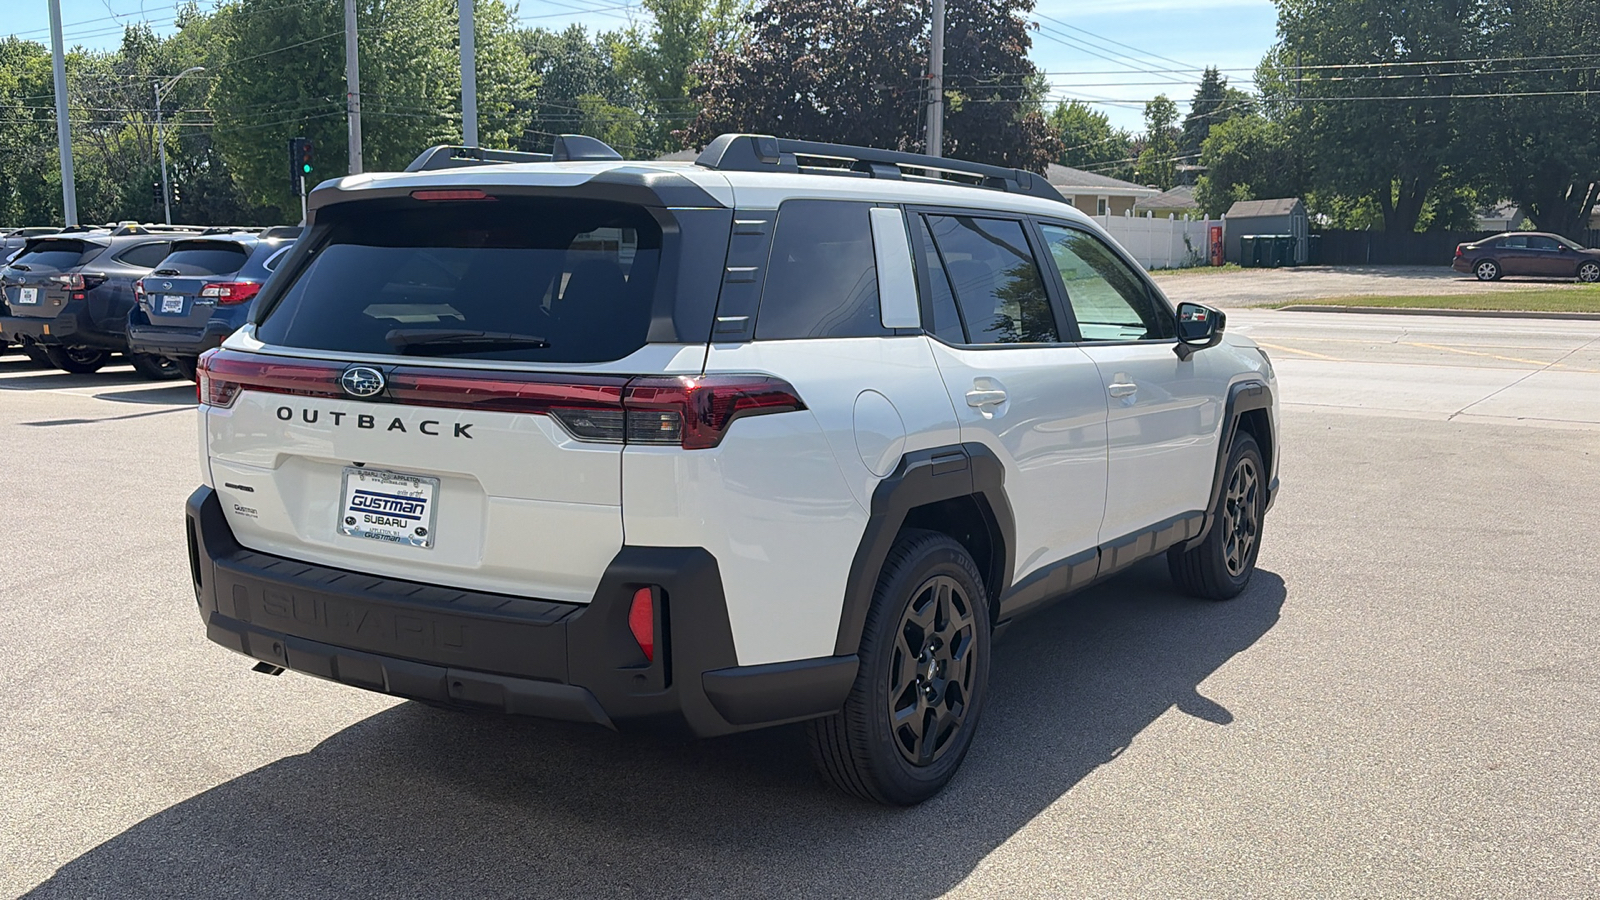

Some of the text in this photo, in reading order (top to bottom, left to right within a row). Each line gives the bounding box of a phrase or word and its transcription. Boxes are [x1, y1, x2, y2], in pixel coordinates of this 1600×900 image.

[276, 406, 473, 439] OUTBACK
[363, 514, 408, 528] SUBARU
[262, 587, 469, 648] SUBARU
